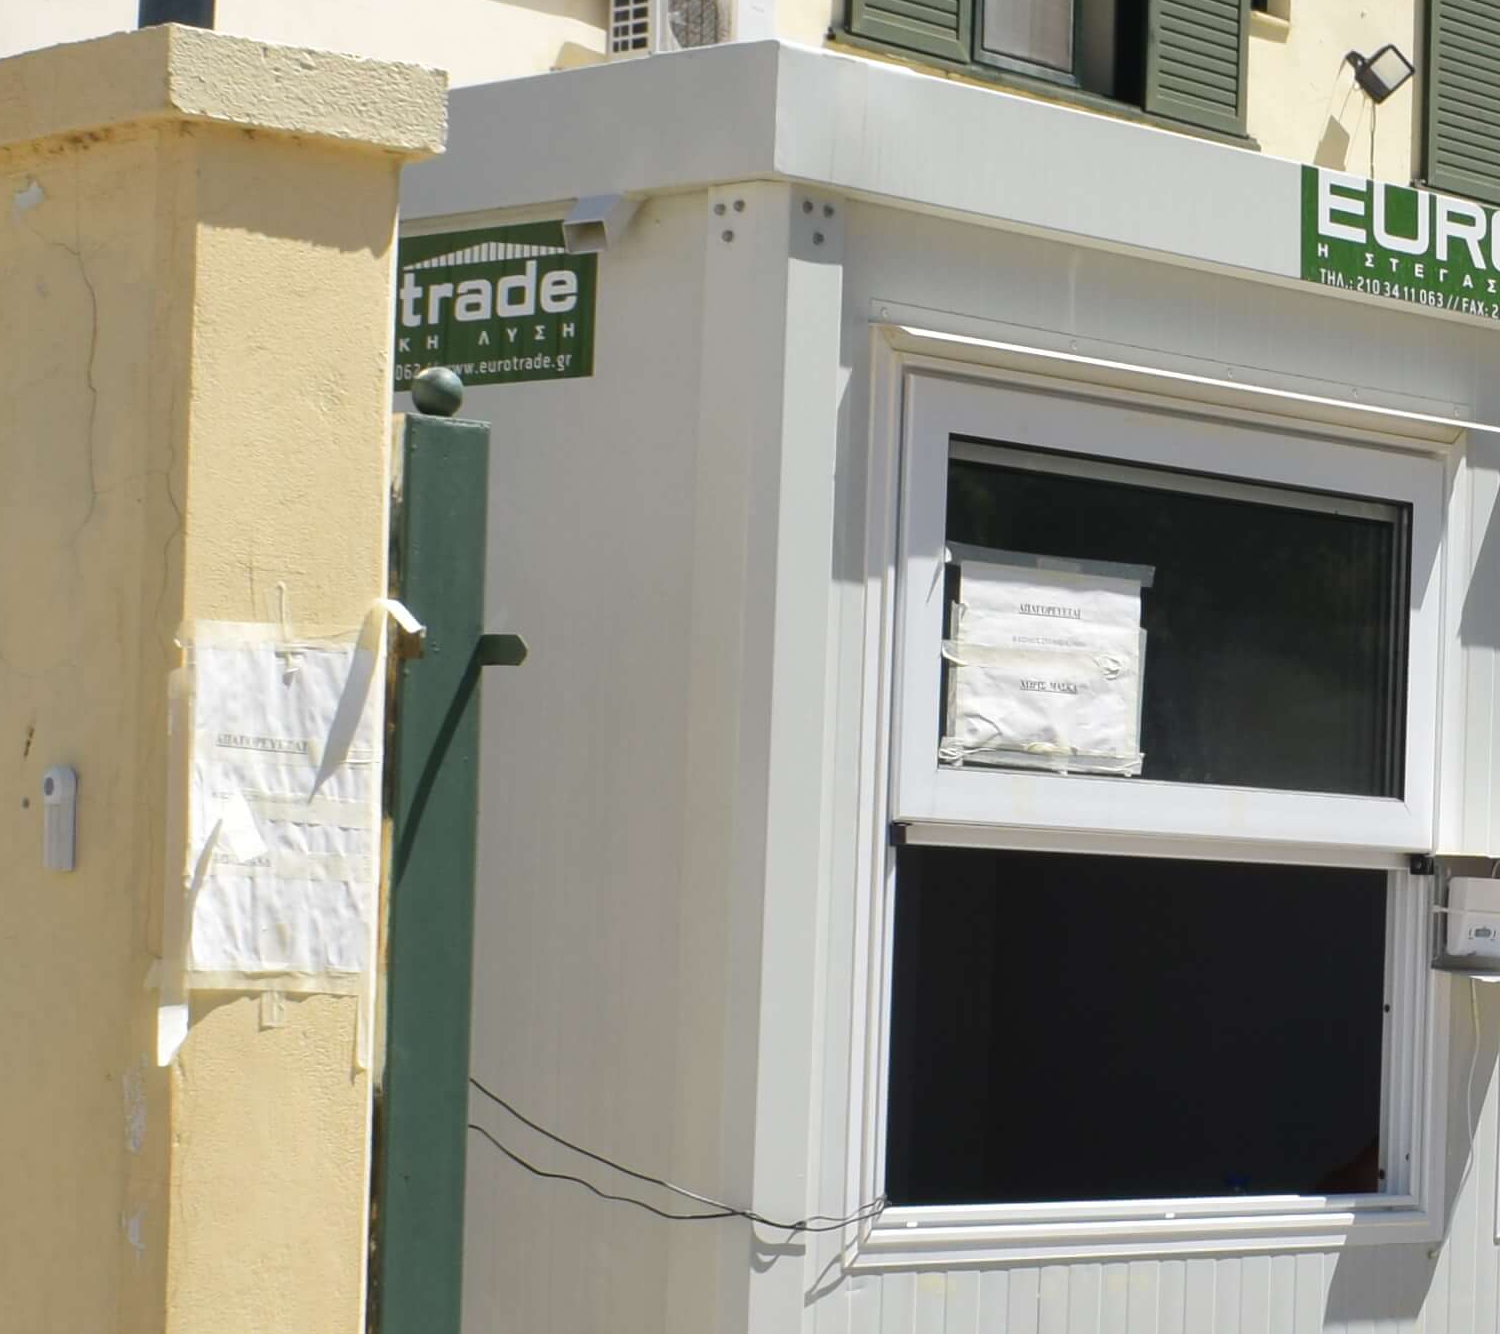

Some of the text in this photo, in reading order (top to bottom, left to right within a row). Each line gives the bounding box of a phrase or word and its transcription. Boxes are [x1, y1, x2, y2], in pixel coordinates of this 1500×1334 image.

[1317, 242, 1329, 259] Η
[399, 259, 578, 328] trade
[1356, 276, 1381, 295] 210
[1383, 281, 1400, 299] 34
[1403, 285, 1416, 303] 11
[1419, 289, 1444, 308] 063
[1462, 297, 1489, 318] FAX:
[477, 322, 576, 346] ΛΥΣΗ
